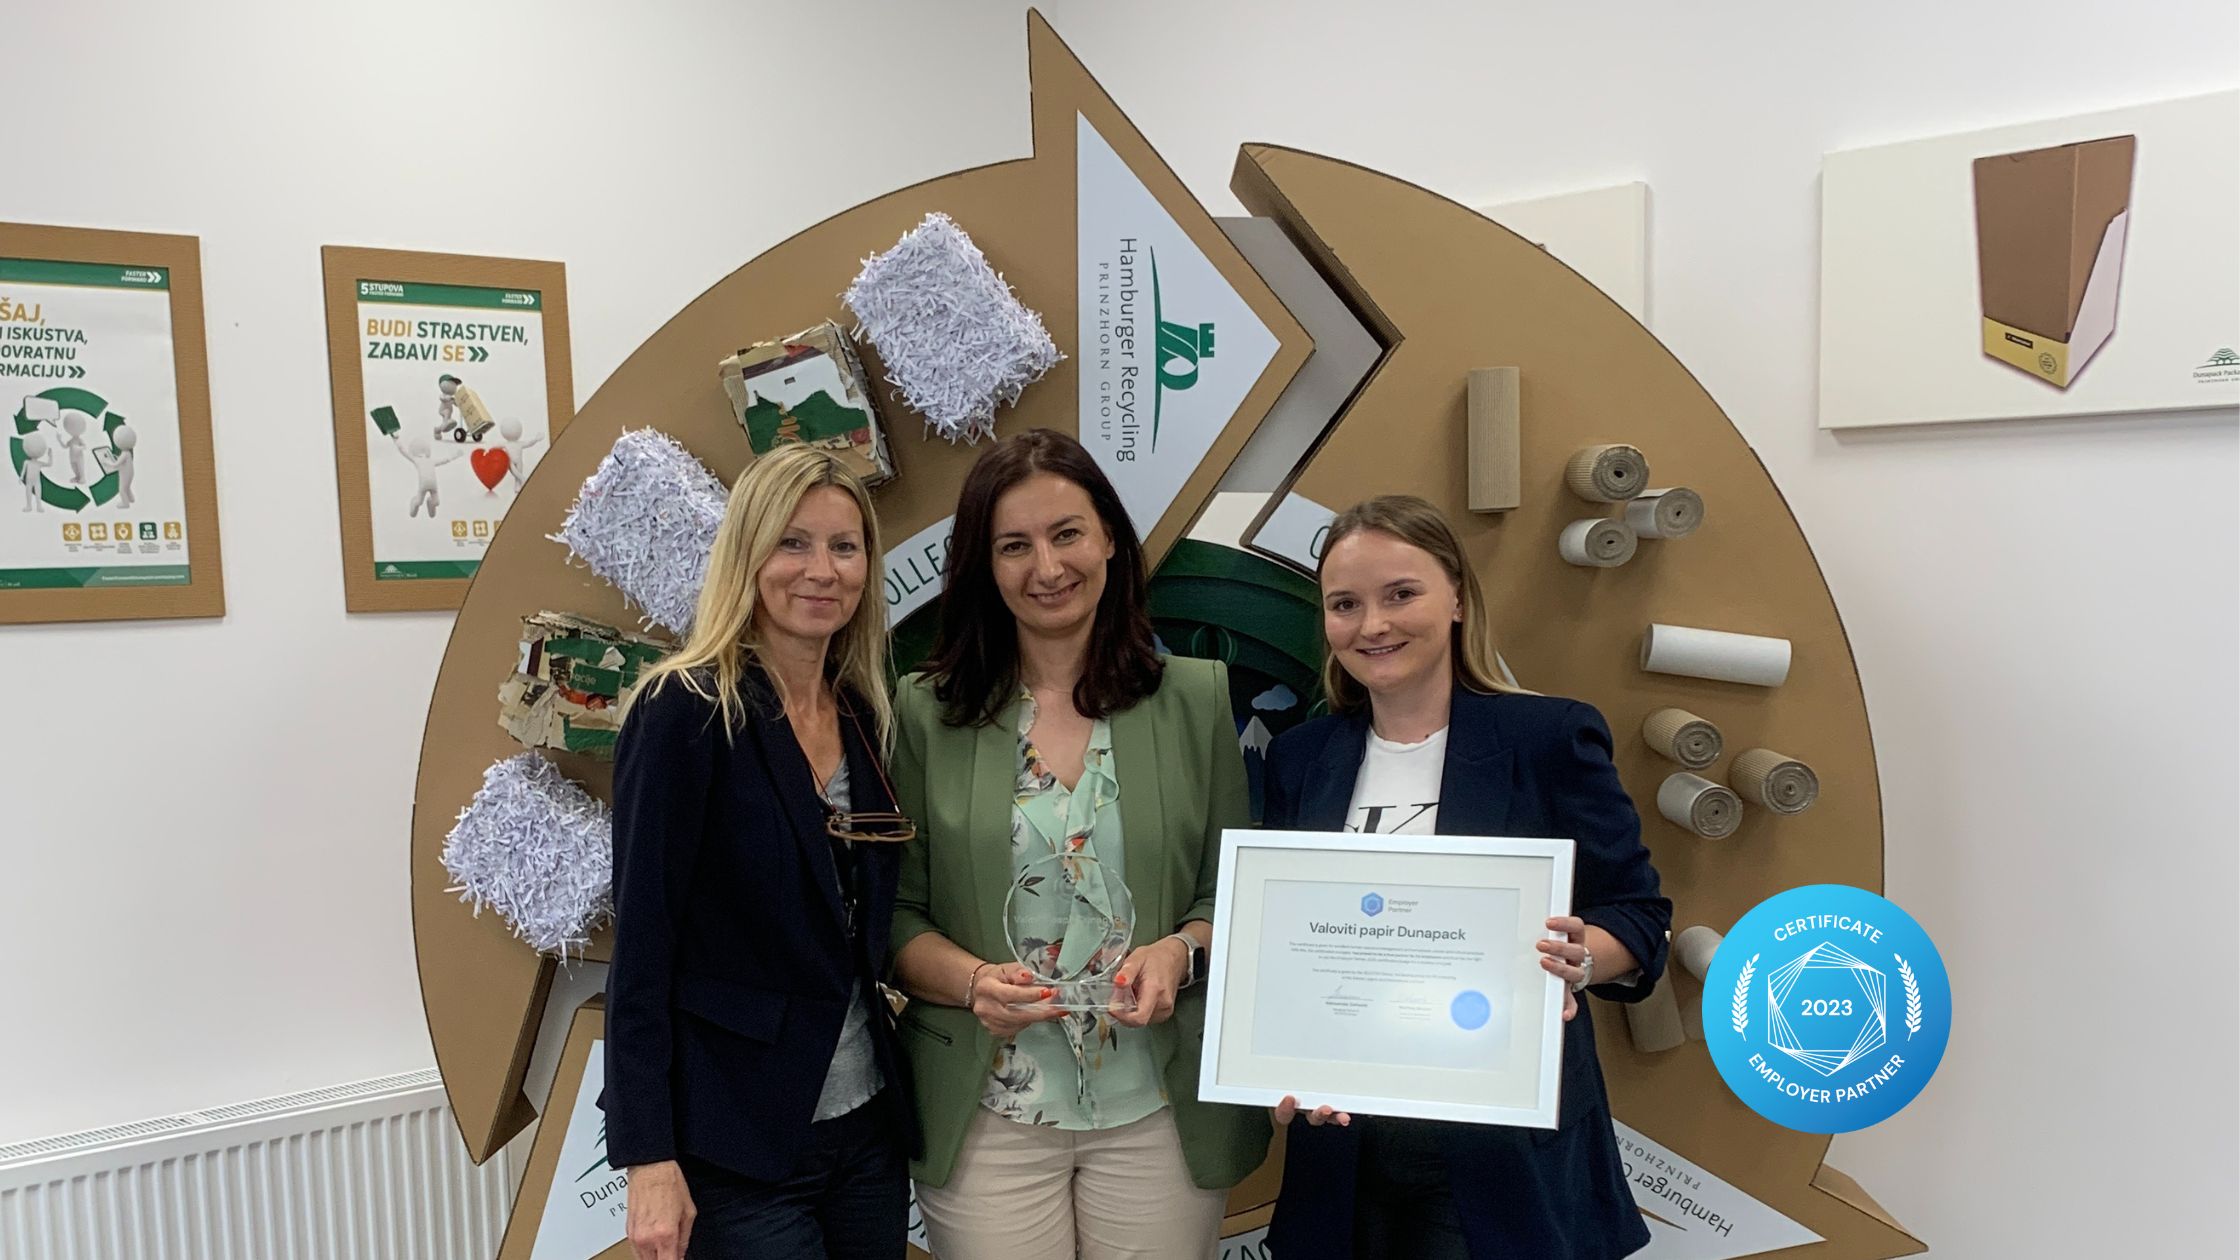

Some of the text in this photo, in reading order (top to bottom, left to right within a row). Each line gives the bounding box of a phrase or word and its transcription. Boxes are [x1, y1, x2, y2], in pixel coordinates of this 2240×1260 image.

[360, 282, 404, 295] 5 STUPOVA
[7, 326, 88, 345] ISKUSTVA,
[366, 319, 528, 346] BUDI STRASTVEN,
[367, 342, 466, 362] ZABAVI SE
[1099, 262, 1111, 440] PRINZHORN GROUP
[1114, 237, 1140, 462] Hamburger Recycling
[1309, 922, 1467, 941] Valoviti papir Dunapack
[580, 1175, 627, 1208] Duna
[1634, 1172, 1734, 1238] Hamburger
